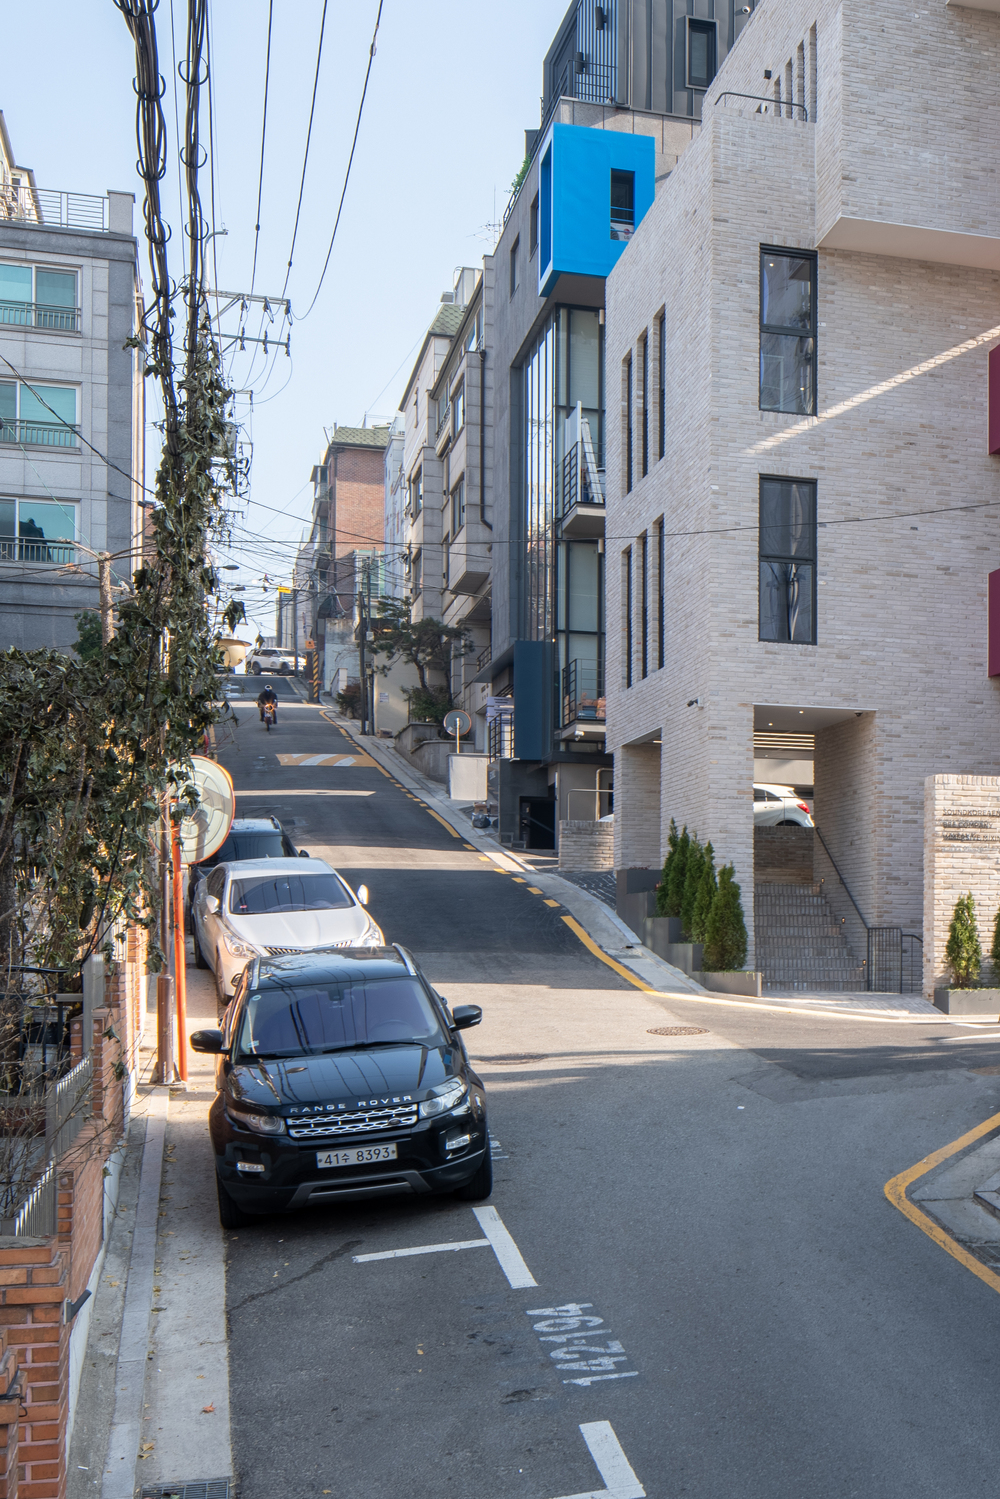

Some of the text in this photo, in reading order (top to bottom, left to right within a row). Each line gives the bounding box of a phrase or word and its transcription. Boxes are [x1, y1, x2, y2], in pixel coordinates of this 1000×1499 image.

[290, 1095, 412, 1113] RANGE ROVER
[324, 1147, 390, 1165] 41수 8393
